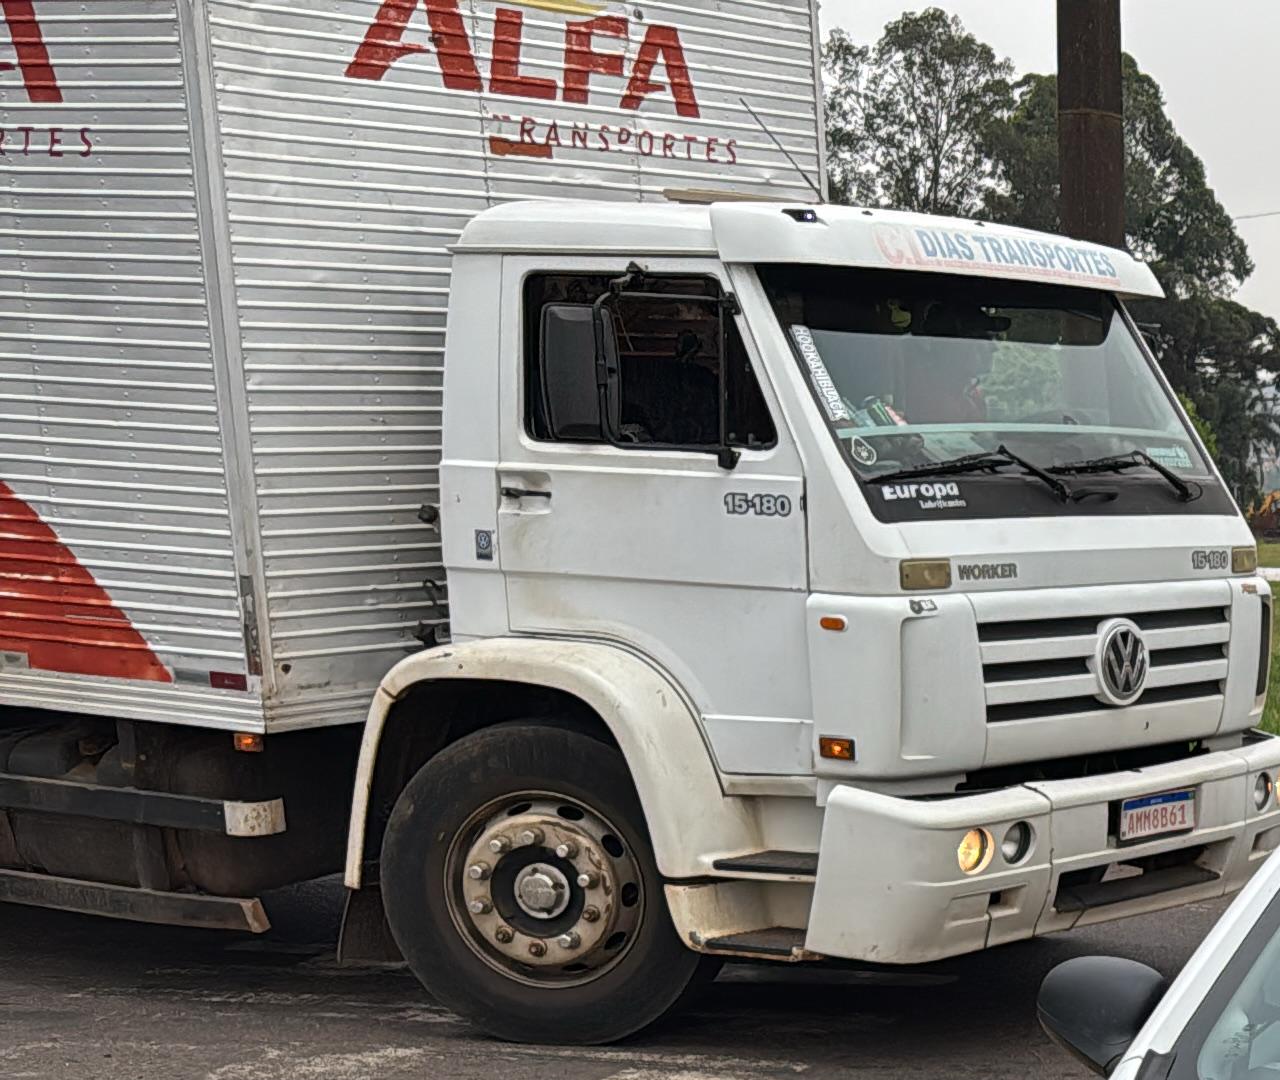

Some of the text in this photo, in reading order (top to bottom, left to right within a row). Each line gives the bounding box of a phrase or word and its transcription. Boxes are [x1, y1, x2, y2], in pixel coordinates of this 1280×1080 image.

[344, 0, 700, 118] ALFA
[493, 114, 737, 164] RANSPORTES
[915, 229, 975, 260] DIAS
[972, 235, 1117, 277] TRANSPORTES
[882, 482, 960, 500] Europa
[957, 563, 1018, 580] WORKER
